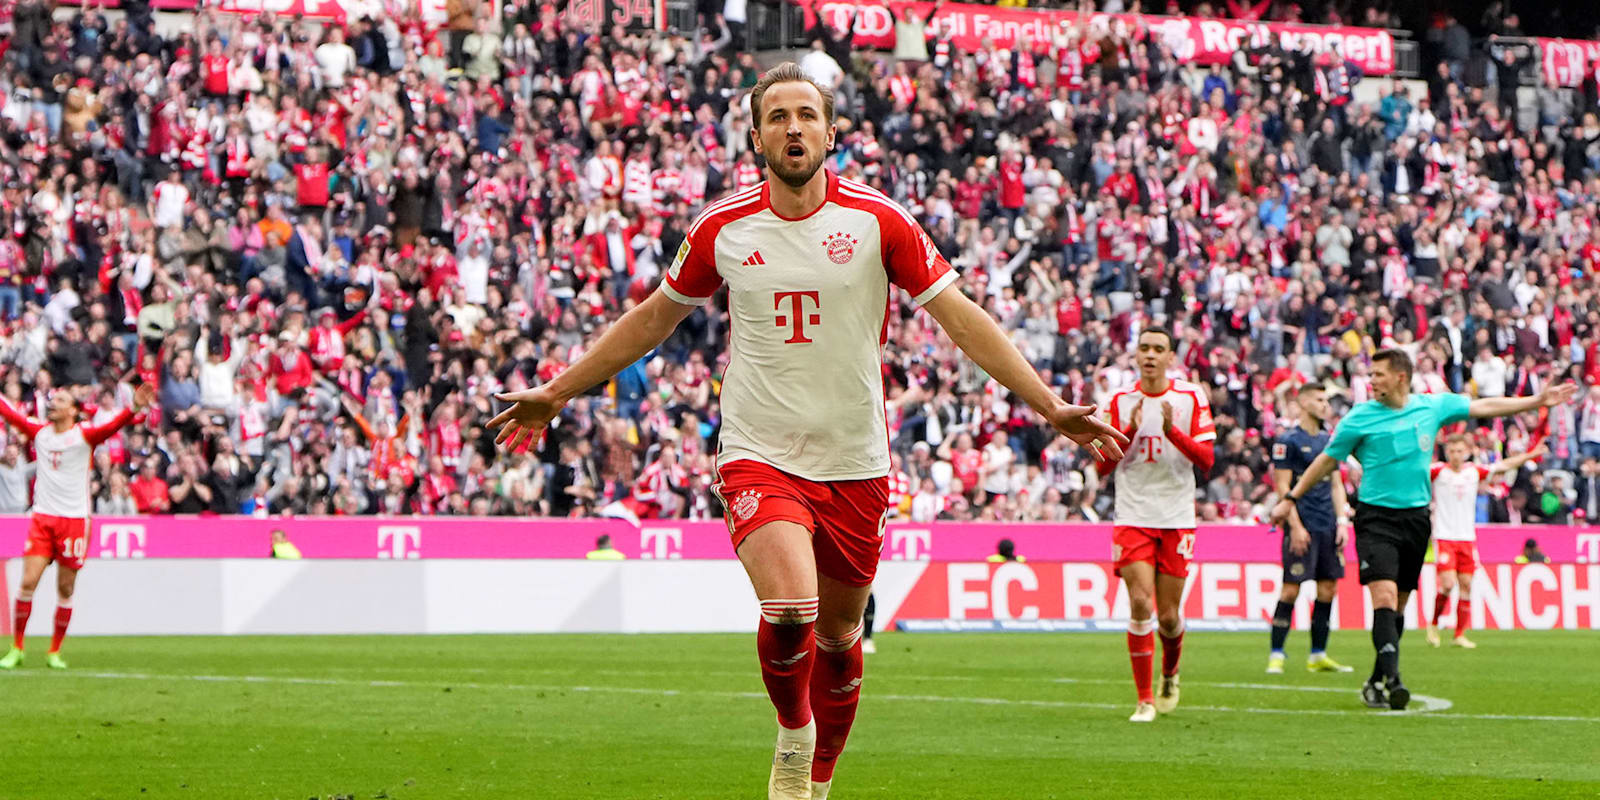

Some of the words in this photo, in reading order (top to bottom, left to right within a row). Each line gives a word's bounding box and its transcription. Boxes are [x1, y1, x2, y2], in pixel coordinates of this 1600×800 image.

[973, 14, 1072, 46] Fanclu
[774, 291, 820, 344] T
[1138, 436, 1162, 463] T
[62, 536, 87, 558] 10
[100, 524, 146, 558] T
[377, 525, 421, 559] T
[641, 528, 682, 560] T
[891, 529, 931, 561] T
[947, 561, 1039, 620] FC
